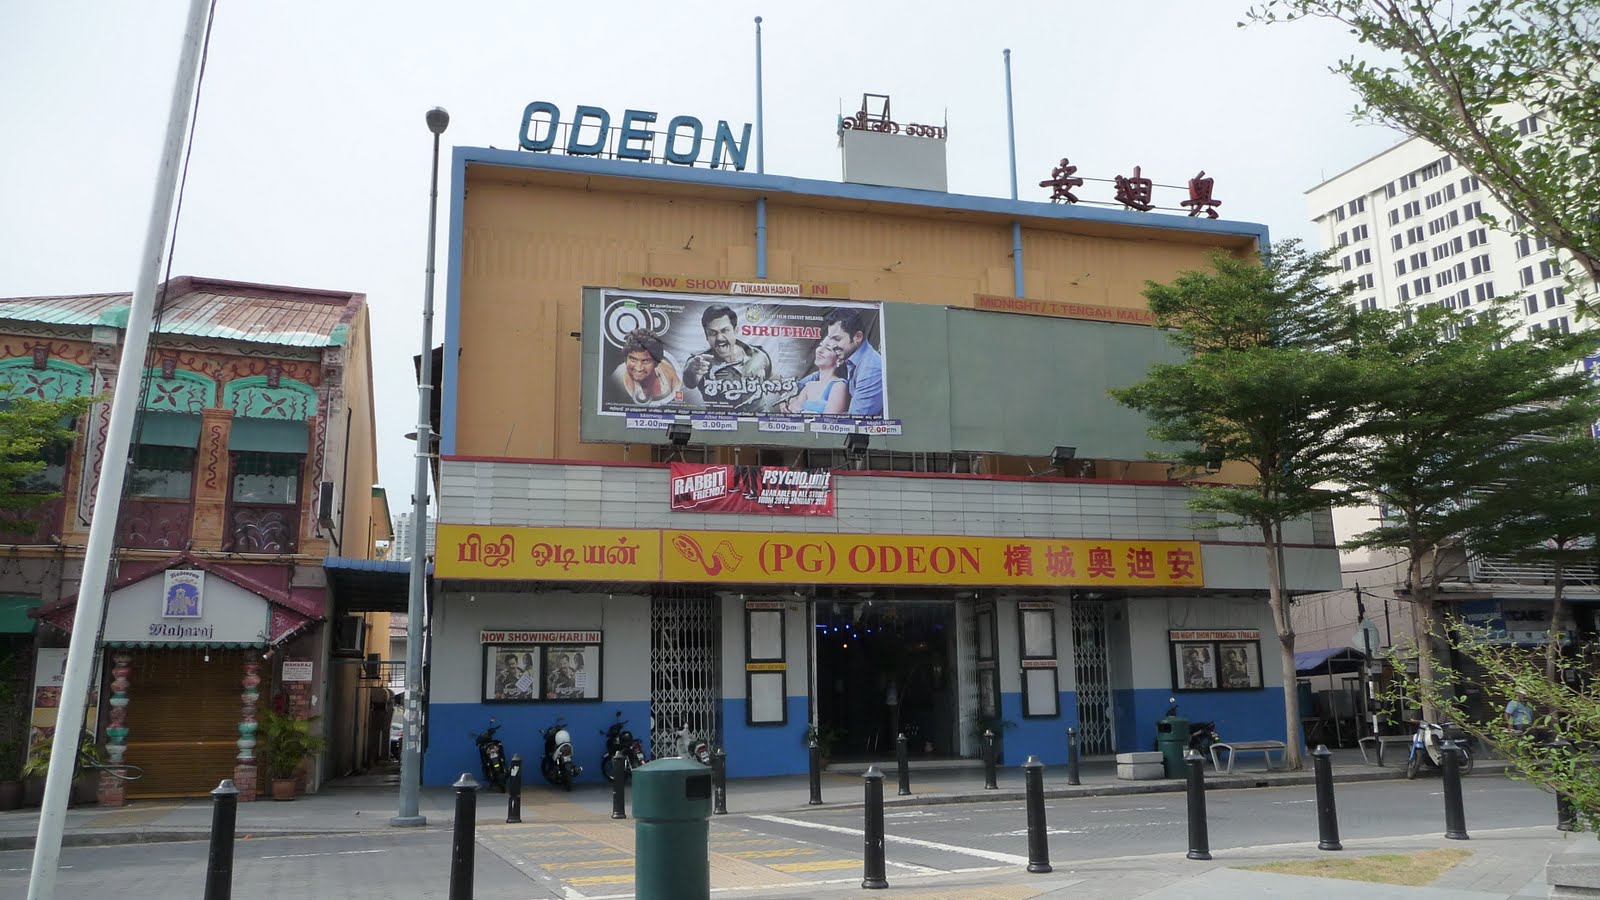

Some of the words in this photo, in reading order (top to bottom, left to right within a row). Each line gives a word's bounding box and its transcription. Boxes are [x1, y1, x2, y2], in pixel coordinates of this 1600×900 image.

[519, 100, 753, 171] ODEON
[641, 276, 678, 288] NOW
[686, 279, 731, 290] SHOW
[740, 284, 770, 293] TUKARAN
[770, 286, 799, 295] HADAPAN
[812, 284, 828, 294] INI
[741, 325, 822, 339] SIRUTHAI
[702, 421, 732, 429] 3.00pm
[675, 470, 725, 496] RABBIT
[762, 470, 831, 486] PSYCHO.unit
[693, 485, 725, 501] FRIENDZ
[760, 489, 790, 497] AVAILABLE
[457, 533, 516, 568] பிஜி
[758, 539, 837, 577] (PG)
[848, 544, 981, 575] ODEON
[149, 623, 214, 639] Maharaj
[481, 632, 505, 642] NOW
[585, 632, 600, 642] INI
